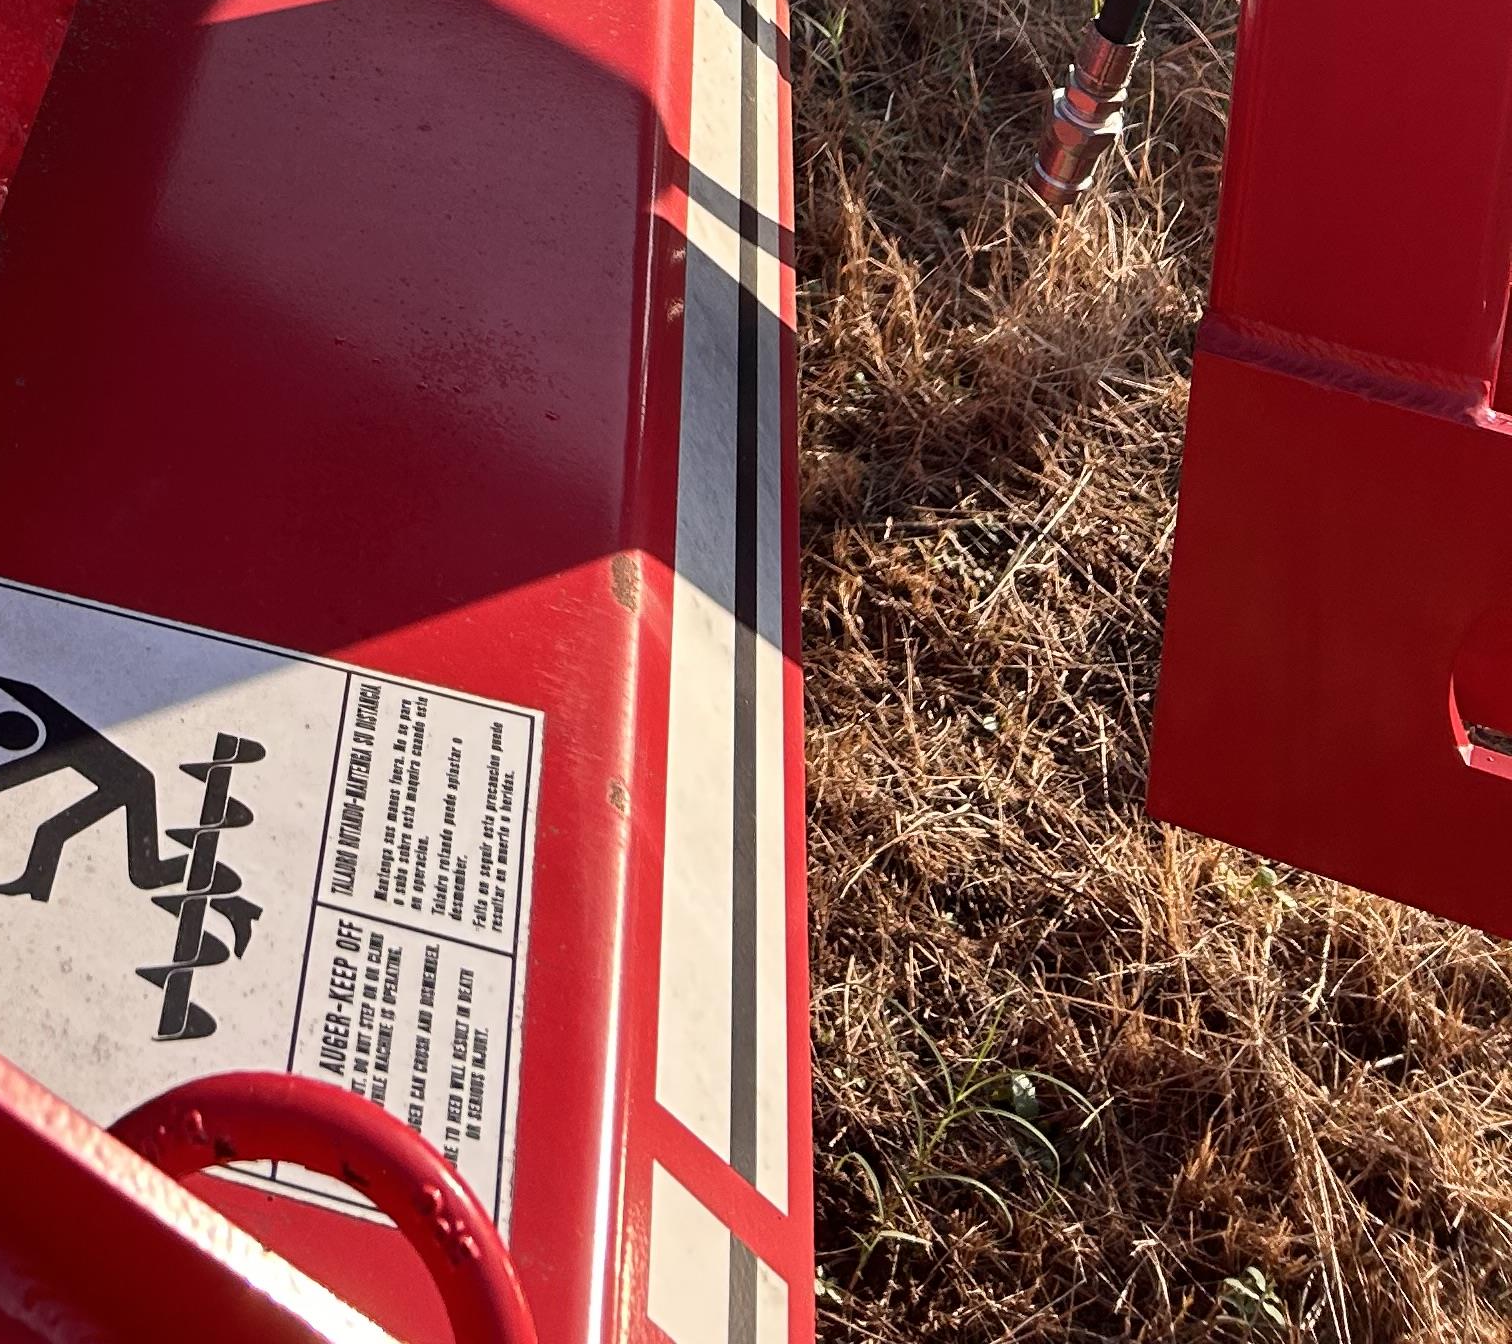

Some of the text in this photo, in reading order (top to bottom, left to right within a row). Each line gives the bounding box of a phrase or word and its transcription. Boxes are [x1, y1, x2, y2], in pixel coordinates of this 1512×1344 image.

[393, 739, 406, 752] No
[398, 724, 408, 735] se
[412, 722, 425, 756] cuando
[491, 722, 503, 752] puede
[446, 747, 461, 790] aplastar
[331, 684, 381, 896] TALADRO ROTANDO-MANTENGA SU DISTANCIA
[387, 789, 400, 822] manos
[402, 806, 415, 829] esta
[443, 794, 456, 826] puede
[384, 826, 395, 845] sus
[482, 815, 494, 839] esta
[397, 833, 411, 864] sobre
[437, 829, 453, 871] rotando
[479, 842, 493, 877] seguir
[497, 826, 509, 865] muerte
[374, 848, 394, 902] Mantenga
[496, 868, 506, 882] en
[411, 897, 422, 911] en
[431, 875, 448, 915] Taladro
[491, 886, 504, 932] resultar
[473, 899, 492, 928] Falta
[319, 919, 363, 1076] AUGER-KEEP OFF
[458, 969, 473, 1003] DEATH
[359, 1002, 375, 1030] STEP
[381, 1008, 395, 1021] IS
[418, 1010, 432, 1034] AND
[356, 1032, 371, 1055] NOT
[374, 1023, 393, 1073] MACHINE
[413, 1035, 430, 1073] CRUSH
[453, 1020, 469, 1061] RESULT
[368, 1076, 387, 1108] HILE
[450, 1065, 465, 1090] WILL
[468, 1072, 485, 1120] SERIOUS
[446, 1127, 460, 1141] TO
